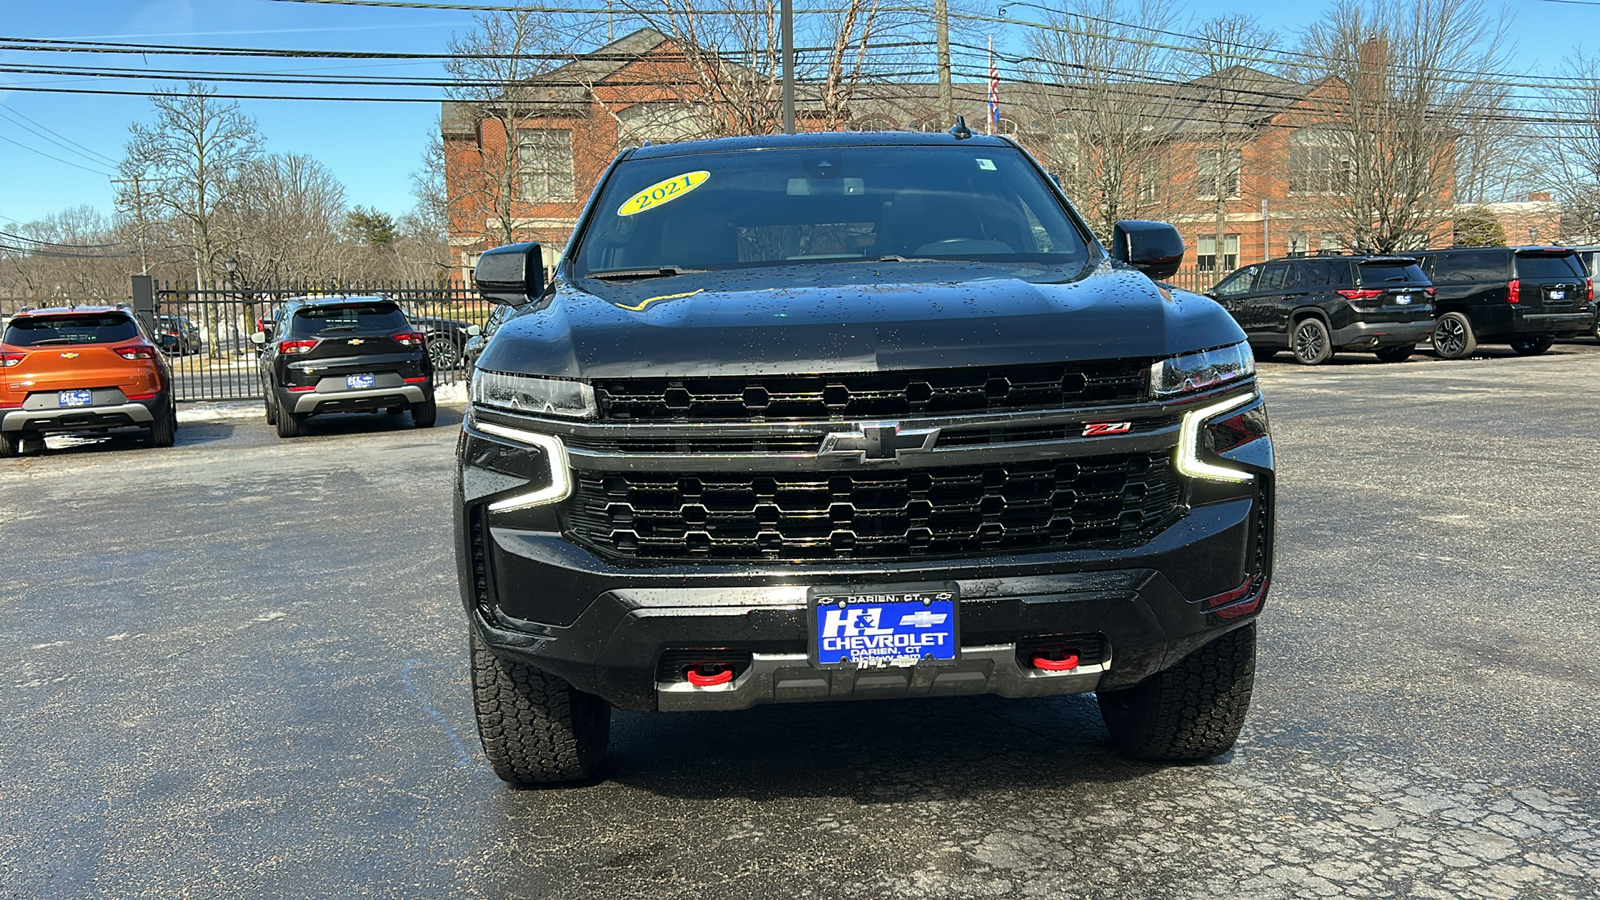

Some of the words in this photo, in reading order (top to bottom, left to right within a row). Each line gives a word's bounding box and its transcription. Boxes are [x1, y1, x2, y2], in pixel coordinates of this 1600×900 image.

[636, 175, 695, 209] 2021
[1081, 421, 1131, 436] Z71
[822, 608, 894, 637] H&L
[823, 633, 948, 650] CHEVROLET
[905, 646, 922, 654] CT
